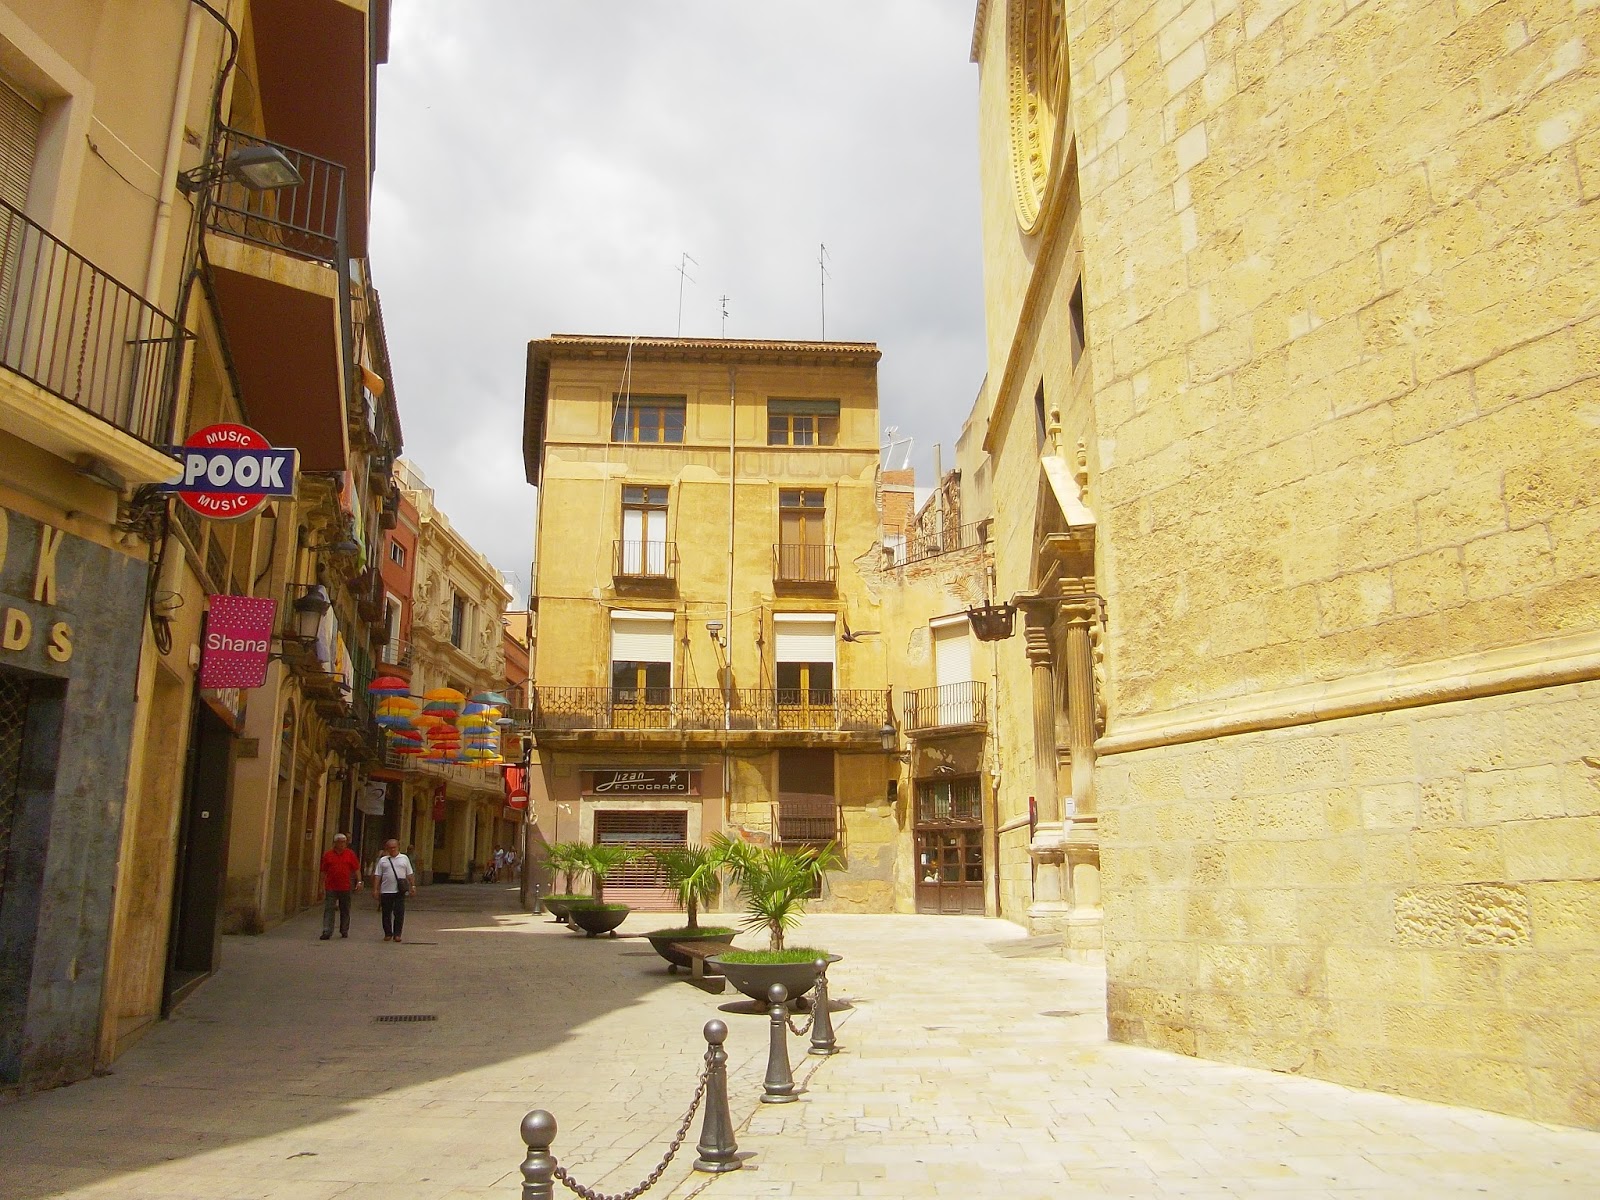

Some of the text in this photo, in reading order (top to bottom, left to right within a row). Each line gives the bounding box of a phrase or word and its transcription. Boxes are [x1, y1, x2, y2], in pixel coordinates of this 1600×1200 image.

[206, 431, 251, 446] MUSIC
[197, 494, 248, 511] MUSIC
[207, 633, 268, 652] Shana
